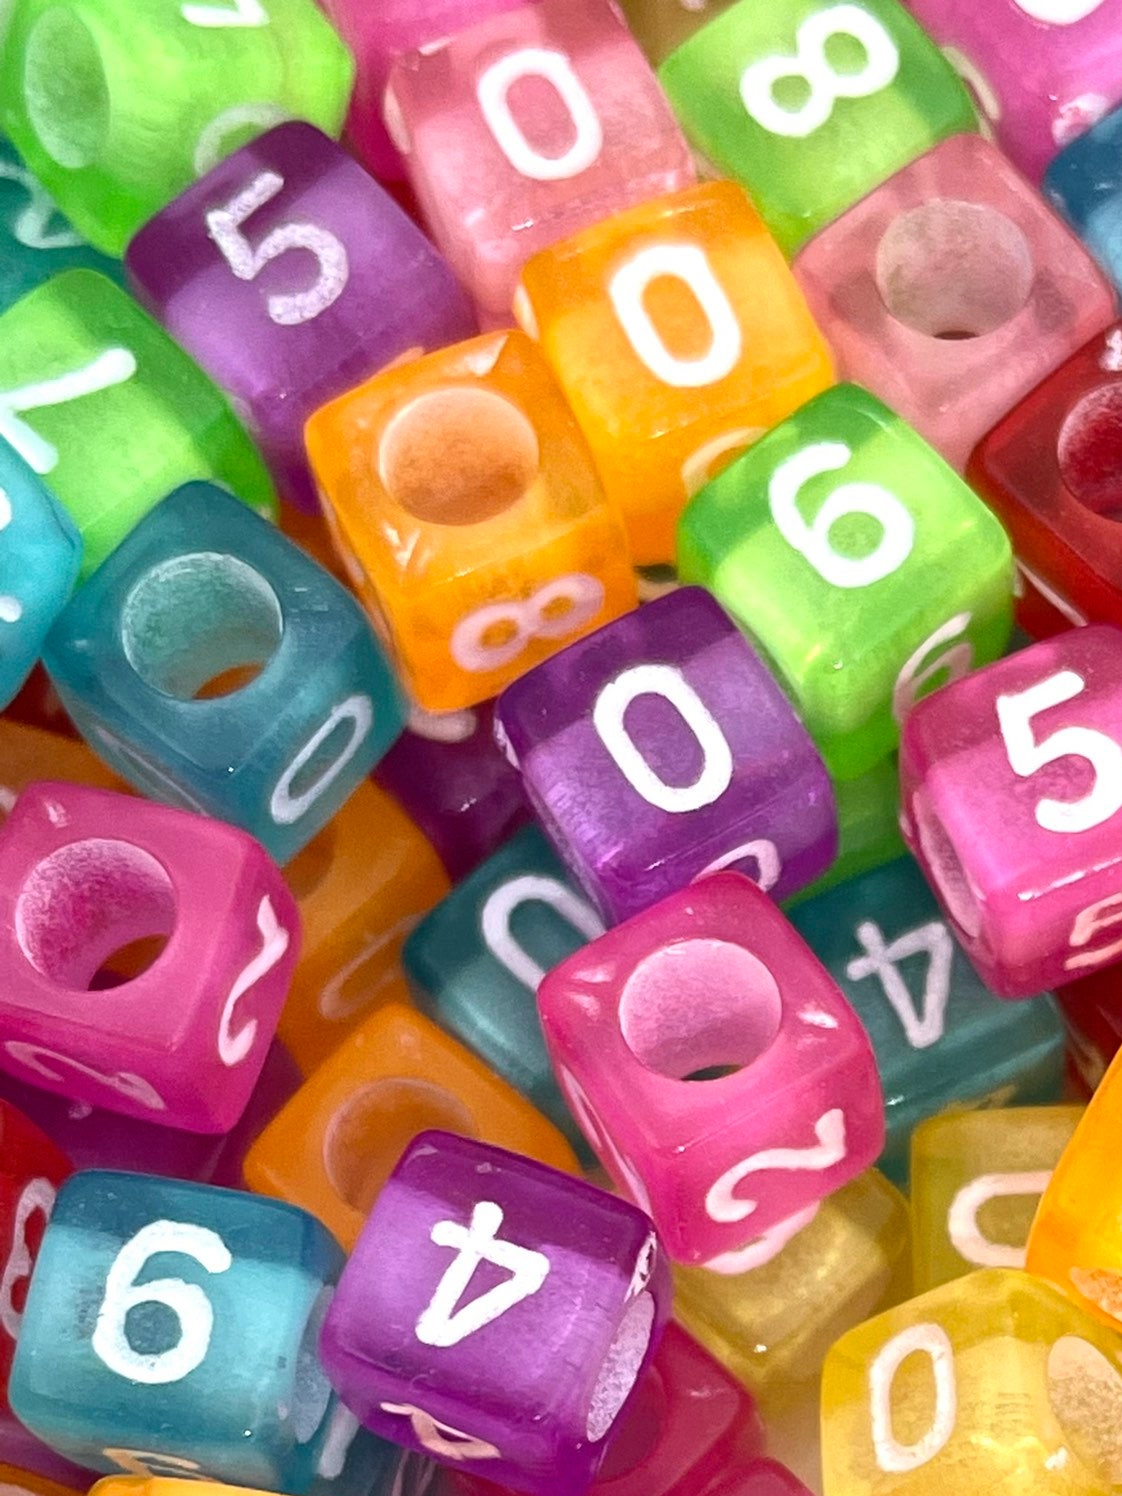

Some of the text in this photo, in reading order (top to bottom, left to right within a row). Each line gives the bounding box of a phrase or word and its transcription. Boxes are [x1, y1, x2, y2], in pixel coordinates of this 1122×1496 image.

[477, 48, 602, 180] 0
[740, 5, 899, 137] 8
[206, 171, 348, 325] 5
[608, 244, 742, 387] 0
[767, 441, 914, 588] 6
[451, 572, 605, 672] 8
[270, 695, 373, 824] 0
[593, 663, 734, 813] 0
[847, 921, 953, 1049] 4
[92, 1219, 232, 1384] 6
[415, 1201, 550, 1347] 4
[870, 1322, 956, 1474] 0
